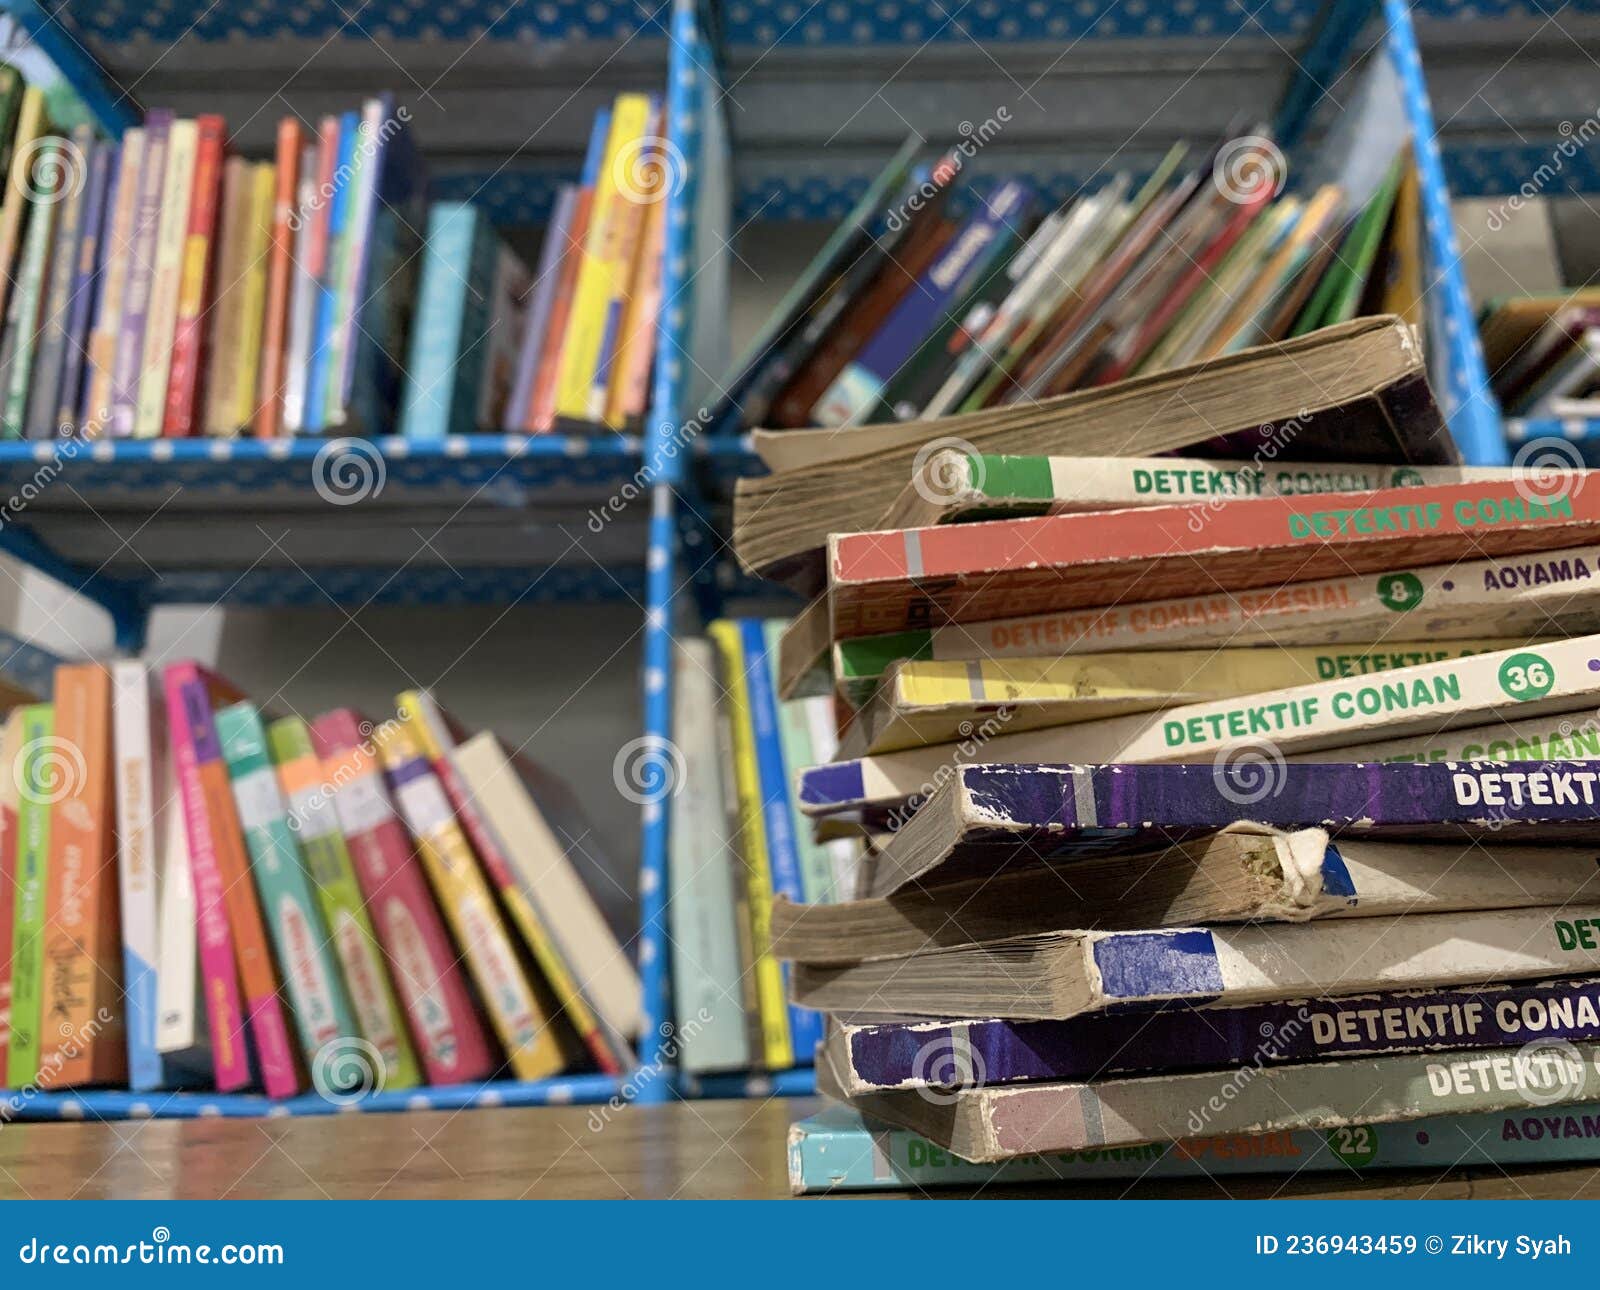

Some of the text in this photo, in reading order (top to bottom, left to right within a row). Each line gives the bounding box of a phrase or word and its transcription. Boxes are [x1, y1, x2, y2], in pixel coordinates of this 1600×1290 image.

[1132, 469, 1266, 495] DETEKTIF
[1288, 494, 1574, 539] DETEKTIF CONAN
[991, 612, 1119, 650] DETEKTIF
[1129, 600, 1230, 635] CONAN
[1390, 580, 1409, 603] 8
[1484, 557, 1591, 591] AOYAMA
[1164, 662, 1549, 748] DETEKTIF CONAN 36
[1312, 995, 1600, 1045] DETEKTIF CONA
[1426, 1056, 1584, 1097] DETEKTIF
[1337, 1127, 1371, 1154] 22
